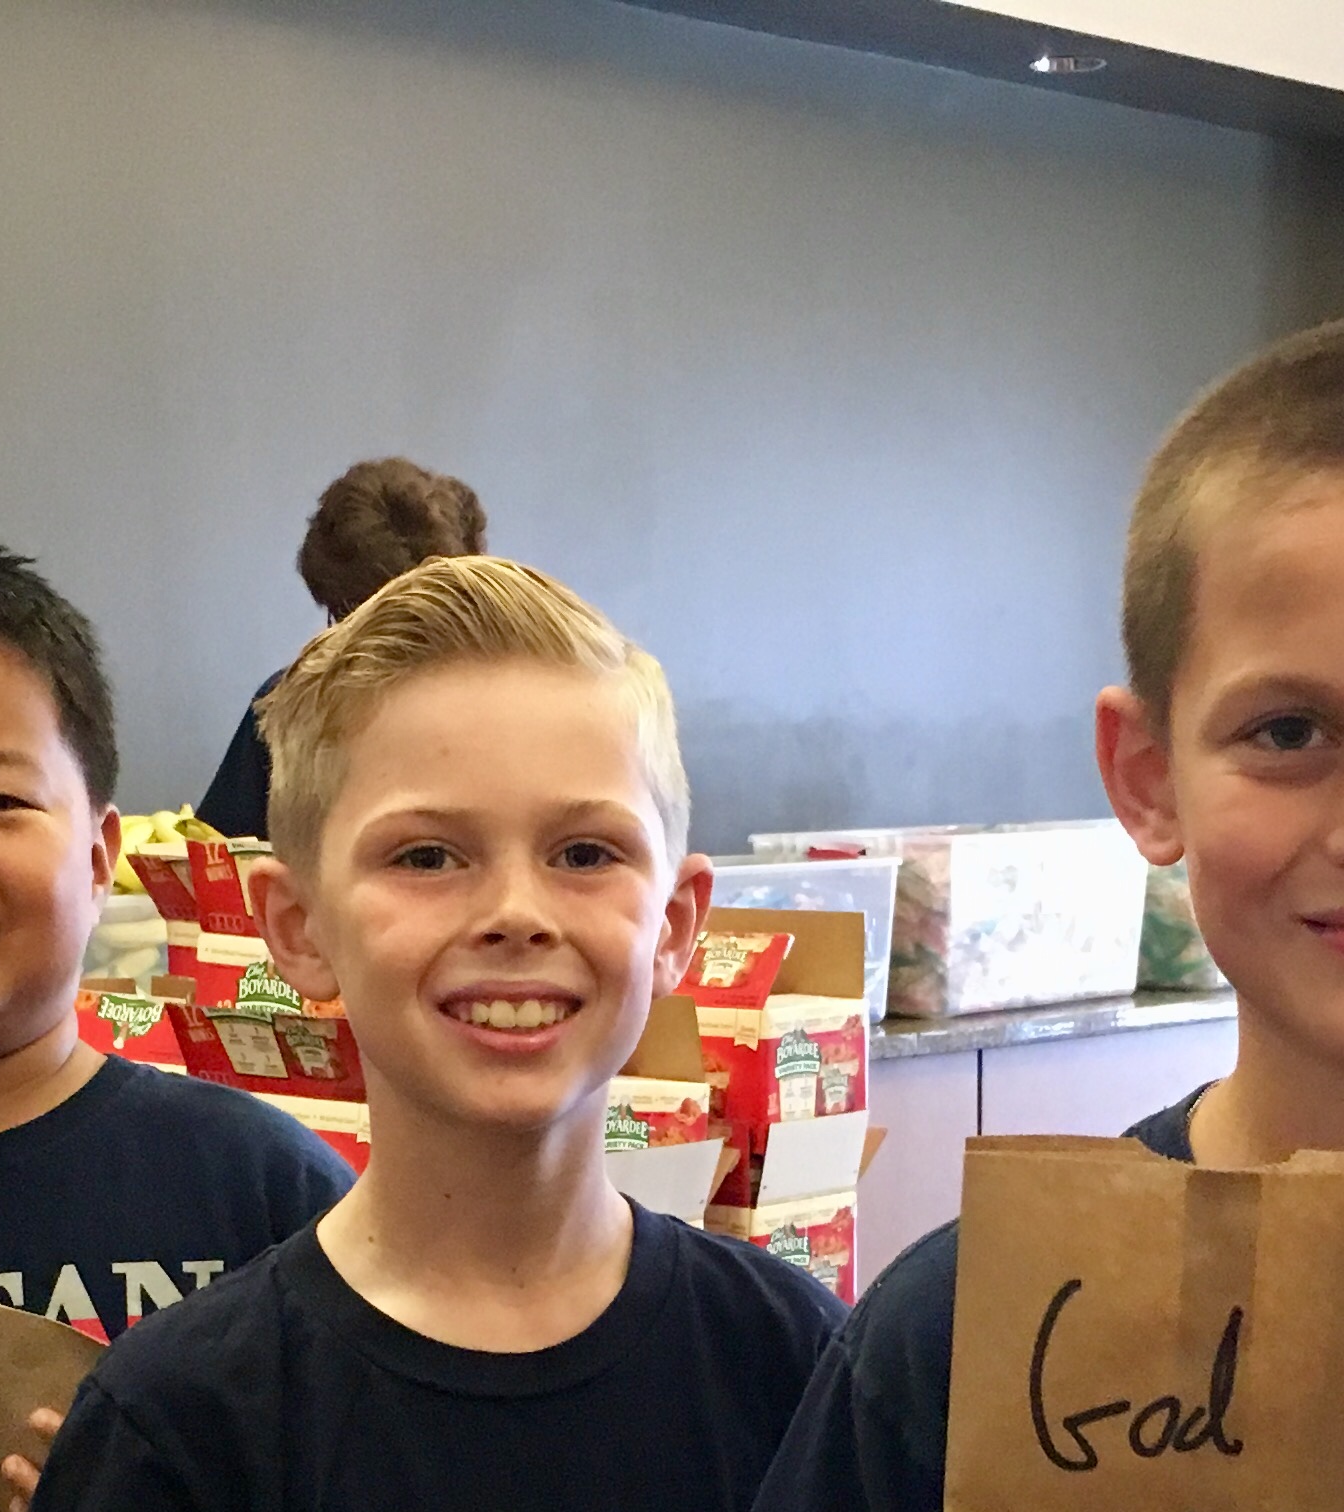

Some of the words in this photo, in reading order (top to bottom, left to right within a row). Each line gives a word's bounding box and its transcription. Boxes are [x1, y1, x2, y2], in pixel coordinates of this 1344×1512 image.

[238, 977, 300, 1006] BOYARDEE
[97, 996, 165, 1023] BOYARDEE
[776, 1040, 820, 1064] BOYARDEE
[605, 1119, 649, 1139] OYARDEE
[1029, 1279, 1244, 1473] God
